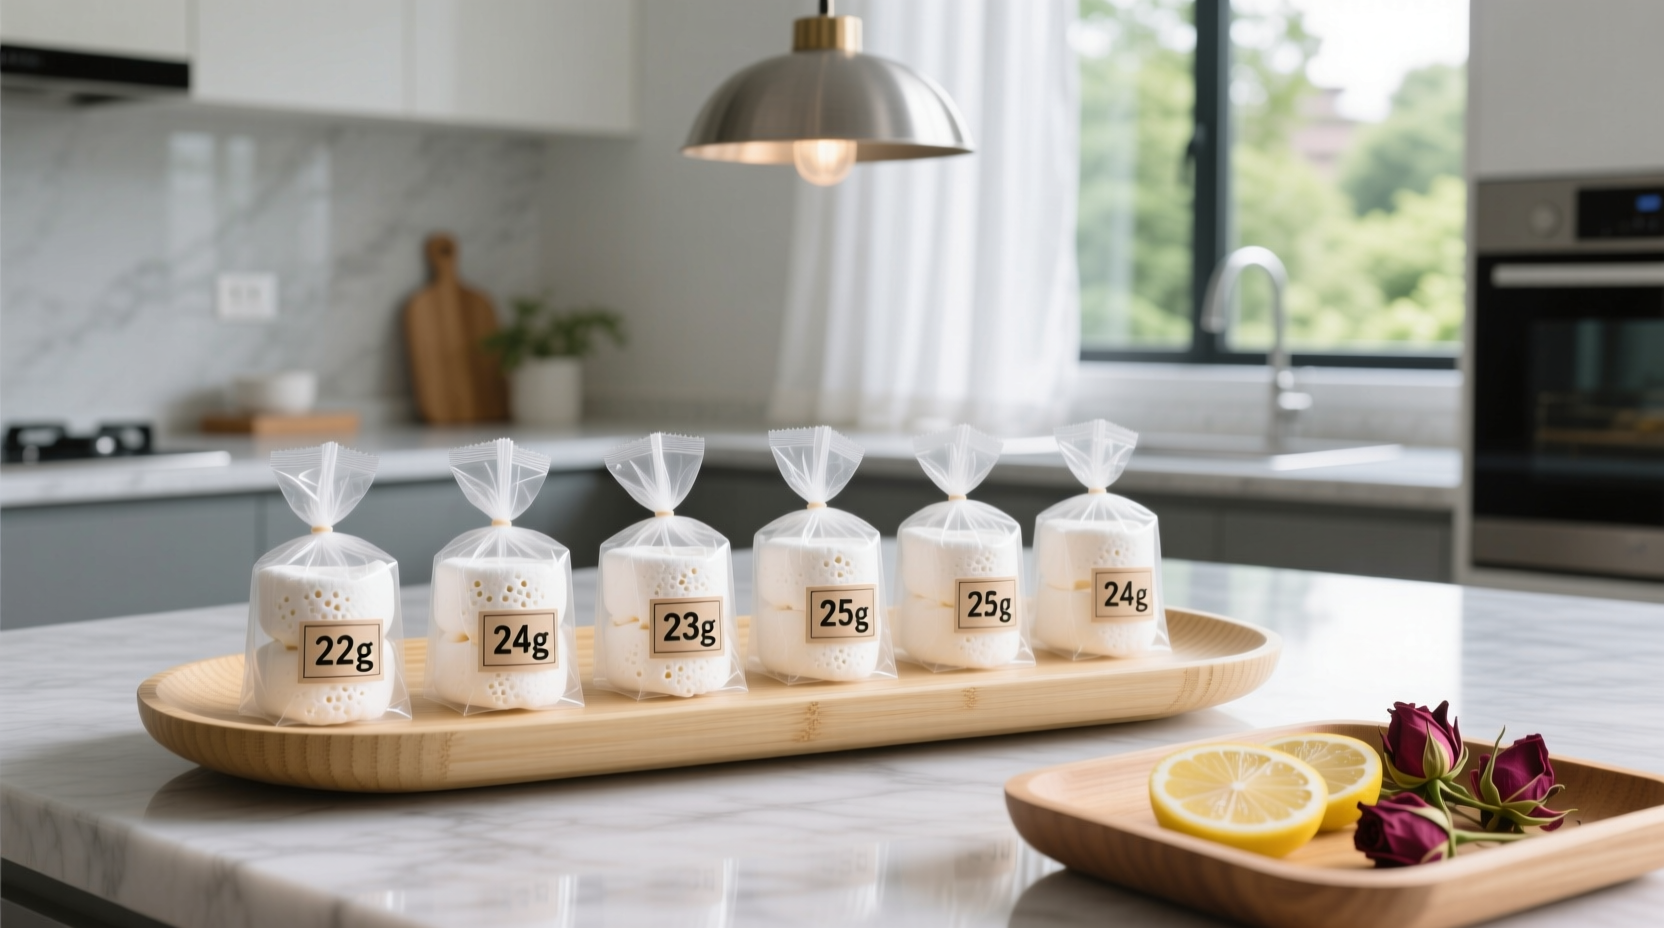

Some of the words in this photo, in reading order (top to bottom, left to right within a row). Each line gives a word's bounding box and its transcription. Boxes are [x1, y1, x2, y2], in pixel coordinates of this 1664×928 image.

[967, 590, 1012, 623] 25g
[1104, 580, 1148, 613] 24g
[663, 611, 716, 648] 23g
[819, 598, 869, 634] 25g
[314, 634, 374, 673] 22g
[493, 624, 549, 661] 24g
